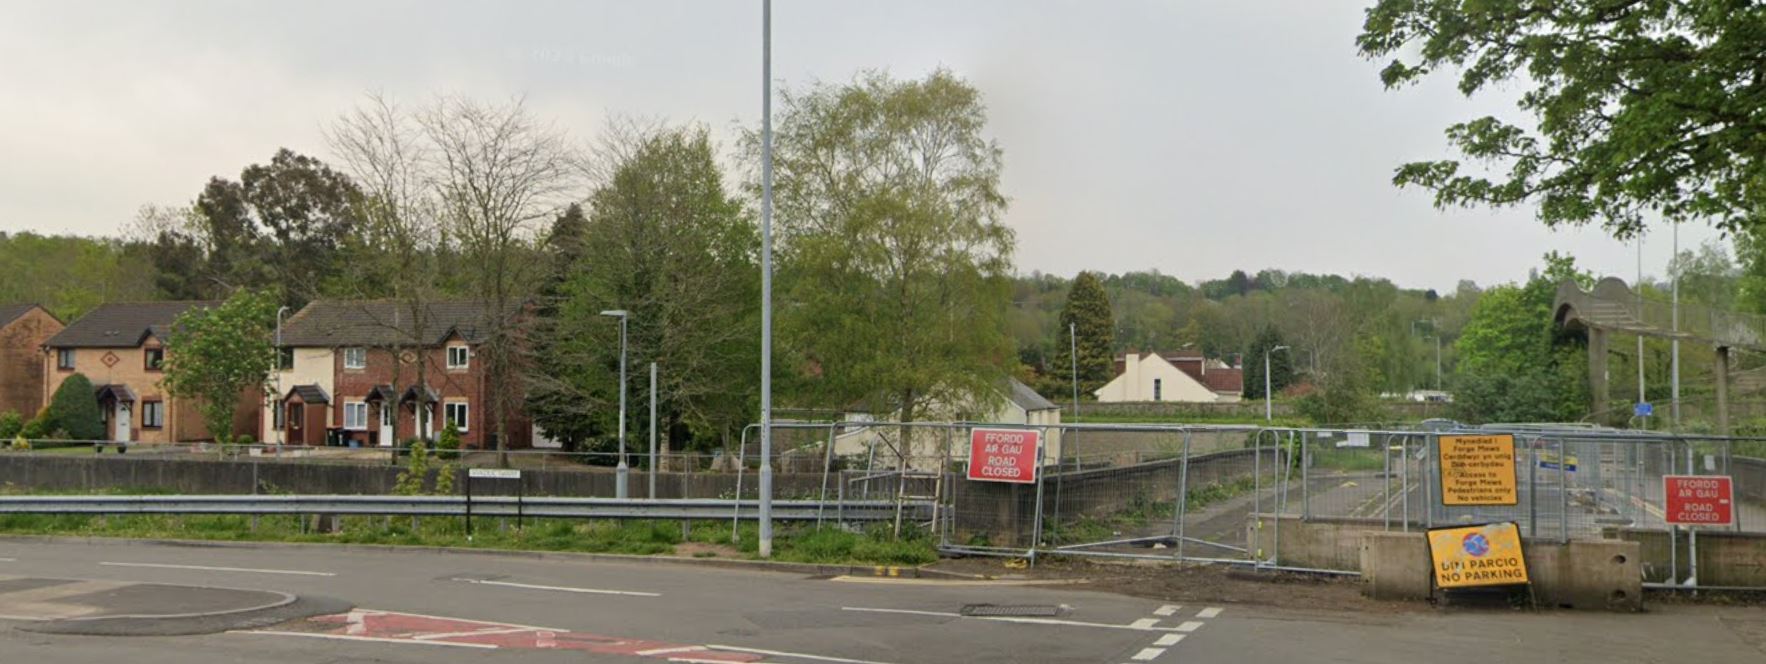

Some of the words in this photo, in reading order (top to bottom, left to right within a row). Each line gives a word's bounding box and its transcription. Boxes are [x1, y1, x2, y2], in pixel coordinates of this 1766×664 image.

[985, 433, 1024, 444] FFORDD
[984, 443, 999, 453] AR
[1001, 444, 1023, 454] GAU
[988, 456, 1017, 467] ROAD
[981, 466, 1021, 477] CLOSED
[1677, 479, 1718, 489] FFORDD
[1679, 489, 1693, 497] AR
[1695, 489, 1718, 498] GAU
[1684, 503, 1713, 512] ROAD
[1678, 512, 1720, 521] CLOSED
[1470, 557, 1518, 569] PARCIO
[1441, 572, 1460, 582] NO
[1465, 568, 1522, 580] PARKING
